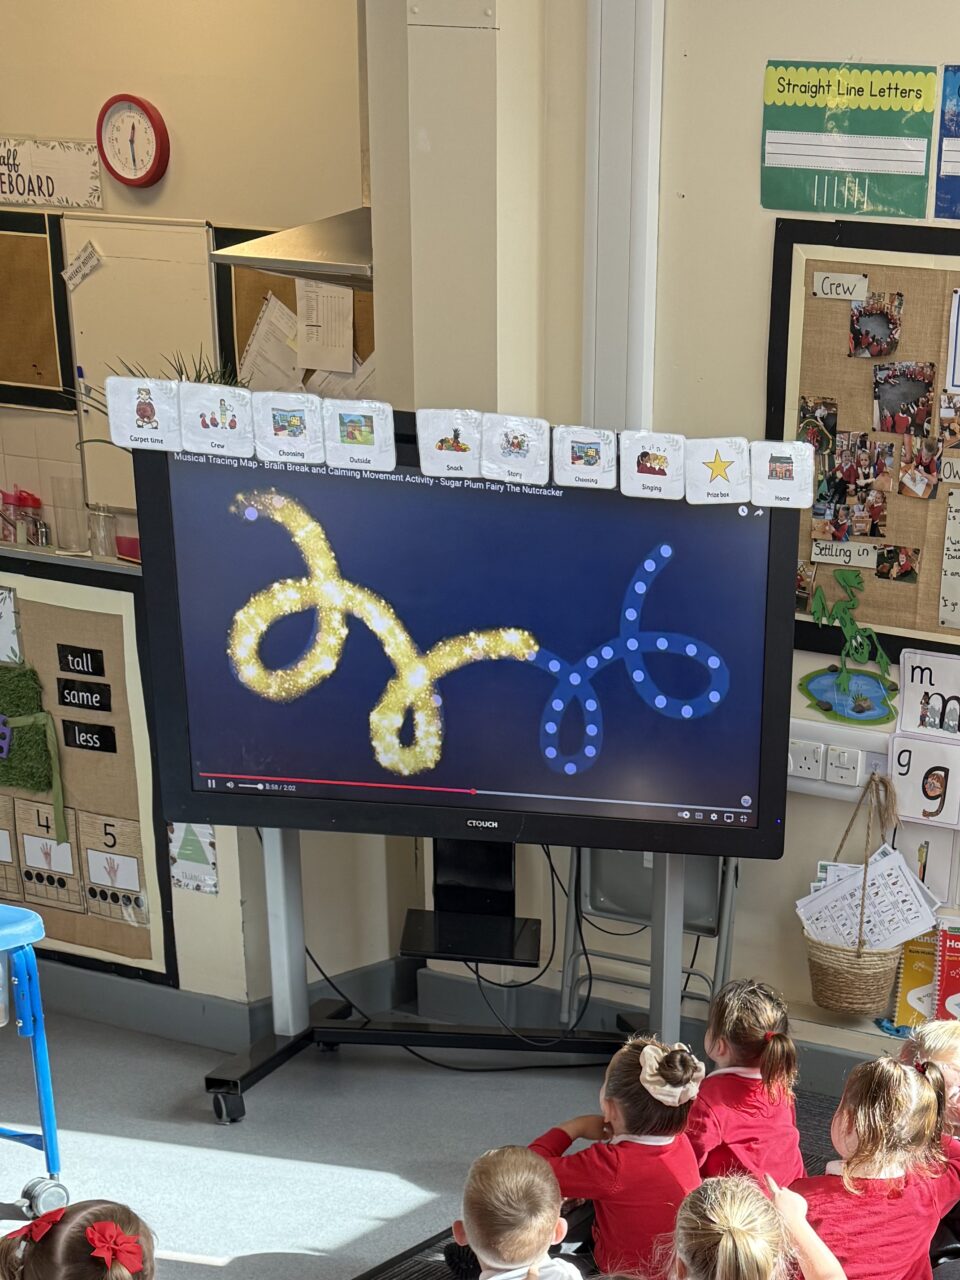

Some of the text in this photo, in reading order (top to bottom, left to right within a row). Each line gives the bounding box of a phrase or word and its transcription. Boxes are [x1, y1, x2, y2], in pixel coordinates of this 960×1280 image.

[777, 77, 922, 100] Straight Line Letters
[821, 276, 856, 296] Crew
[174, 452, 563, 496] Musical Tracing Map Brain Break and Calming Movement Activity Sugar Plum Fairy The Nutcracker
[642, 484, 662, 492] Singing
[814, 542, 869, 564] Settling in
[67, 653, 93, 674] tall
[910, 665, 934, 686] m
[64, 686, 100, 707] same
[75, 727, 100, 748] less
[897, 749, 912, 775] g
[36, 809, 51, 834] 4
[467, 819, 498, 828] CTOUCH
[103, 823, 117, 848] 5
